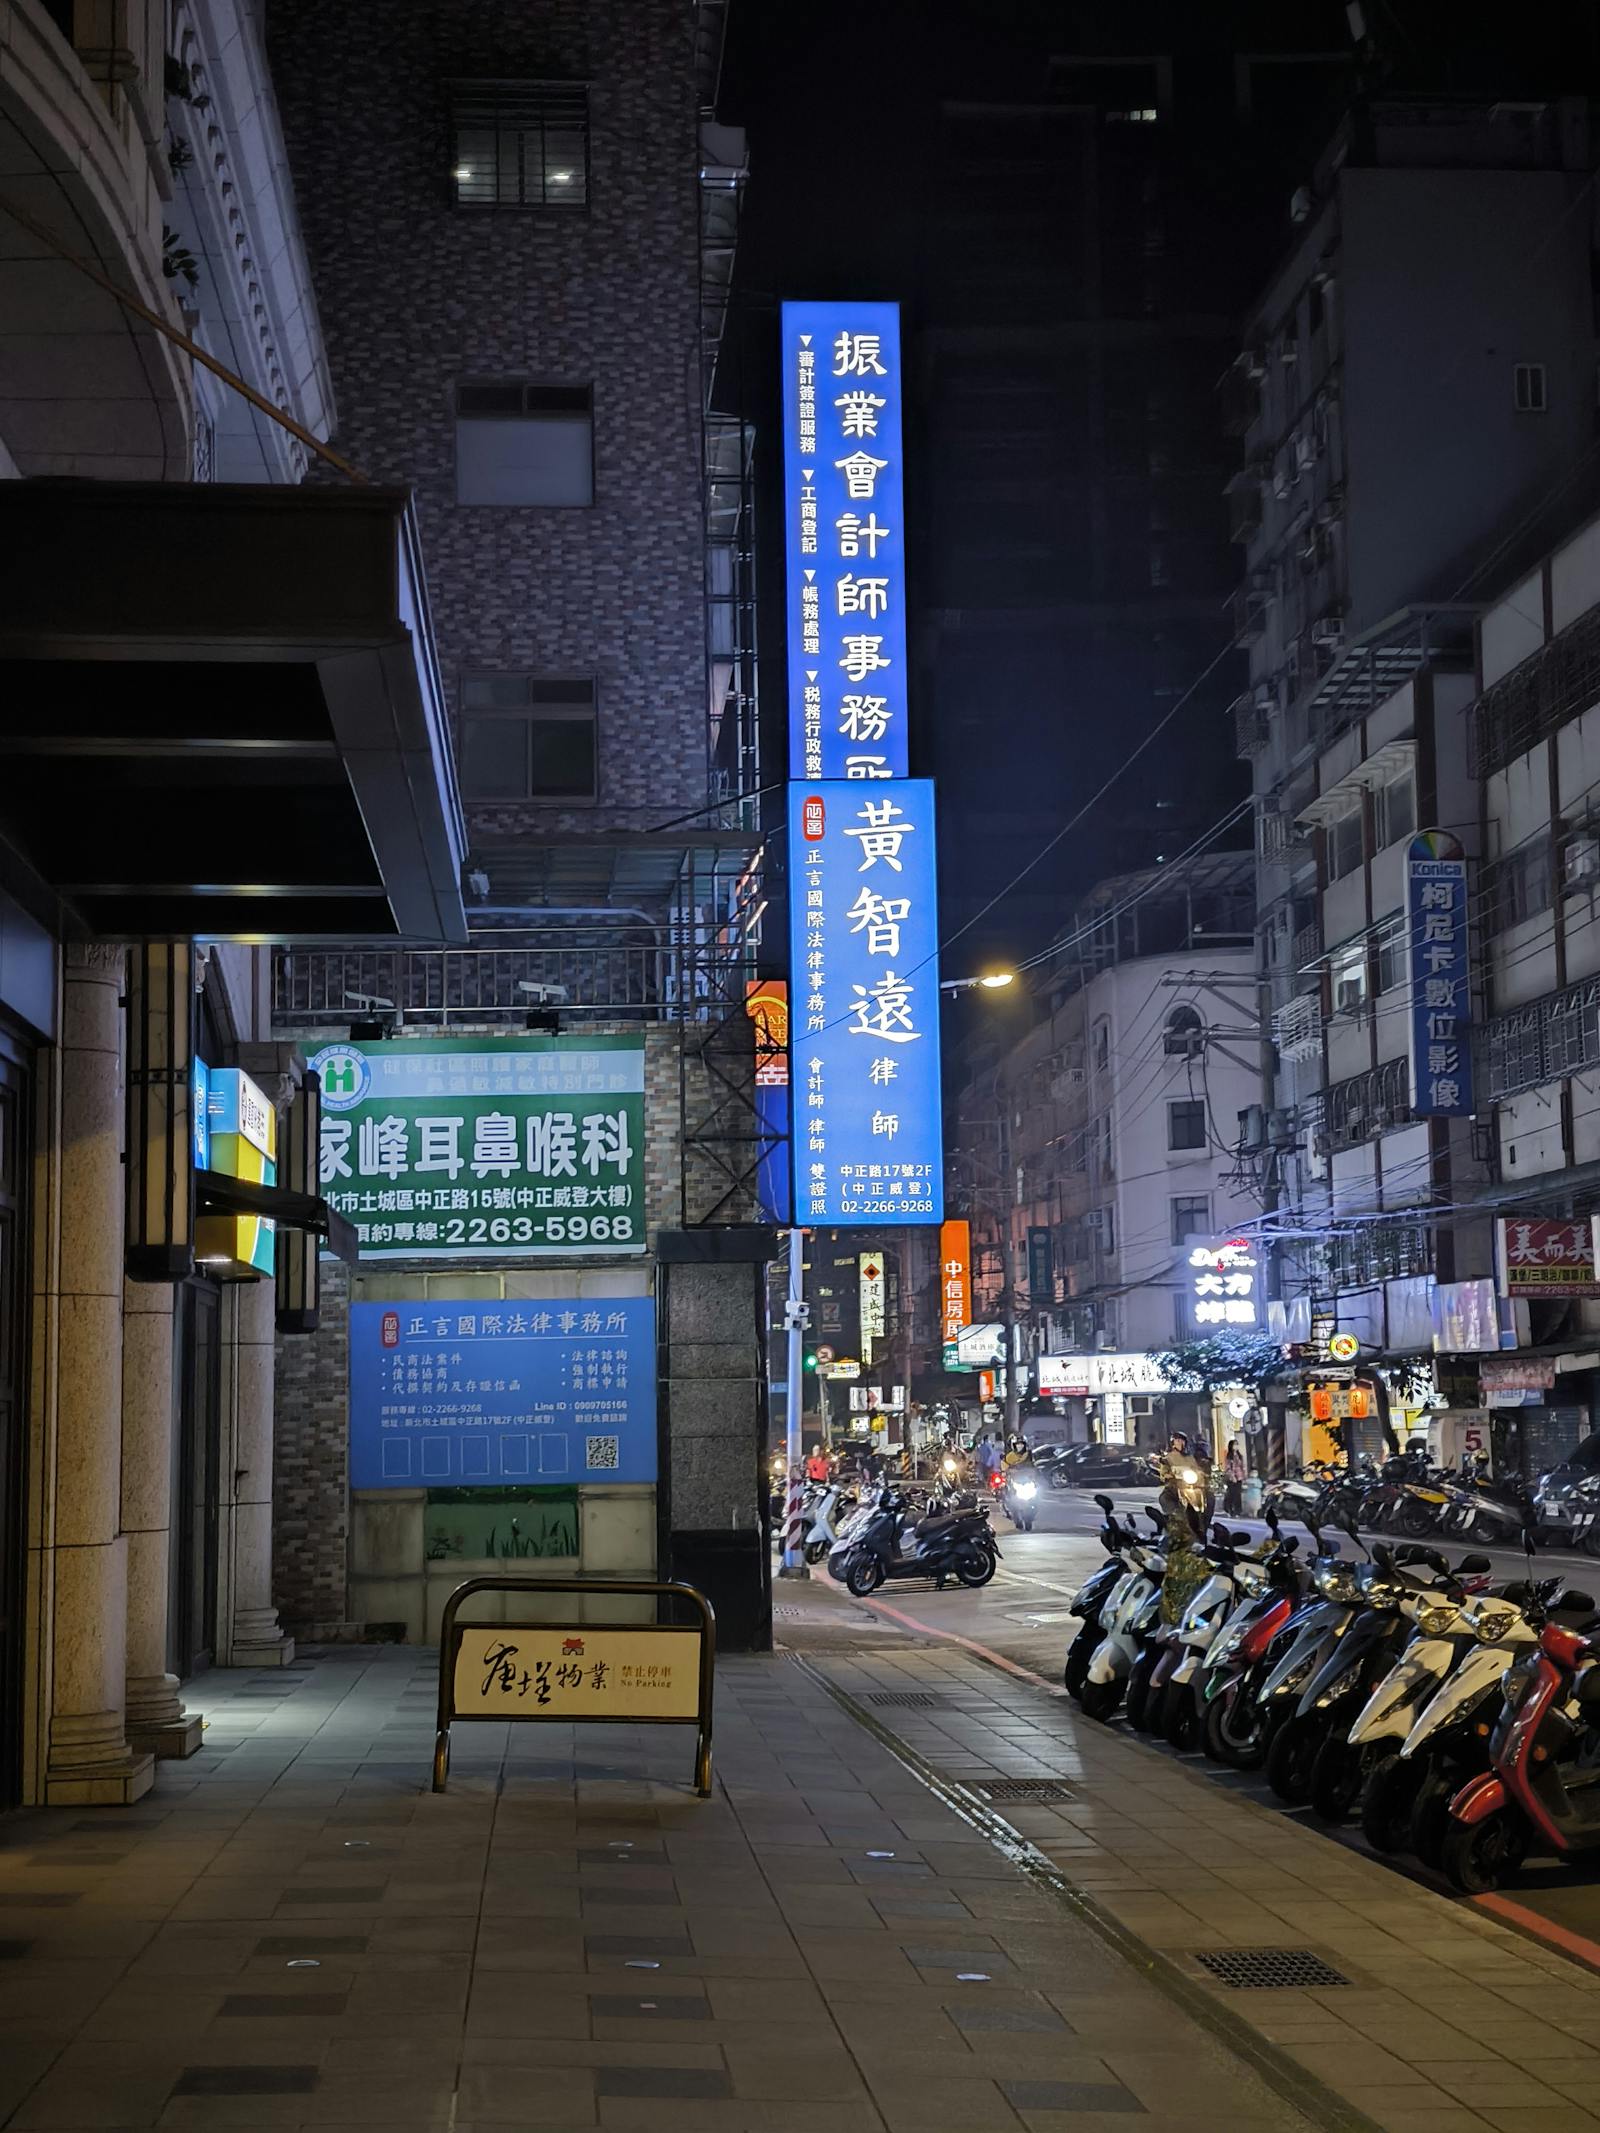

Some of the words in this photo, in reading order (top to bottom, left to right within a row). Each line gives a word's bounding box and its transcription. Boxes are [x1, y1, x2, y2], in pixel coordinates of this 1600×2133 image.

[798, 351, 817, 454] 審計簽證服務
[801, 486, 818, 555] 工商登記
[802, 586, 820, 654] 帳務處理
[1411, 862, 1463, 877] Konica
[805, 850, 826, 1032] 正言國際法律事務所
[1420, 882, 1460, 1108] 柯尼卡數位影像
[808, 1057, 825, 1109] 會計師
[868, 1056, 899, 1140] 律師
[320, 1110, 633, 1183] 家峰耳鼻喉科
[808, 1118, 825, 1153] 律師
[840, 1164, 932, 1178] 中正路17號2F
[841, 1200, 933, 1213] 02-2266-9268
[1510, 1225, 1594, 1265] 美而美
[405, 1311, 628, 1337] 正言國際法律事務所
[1465, 1430, 1482, 1451] 5
[620, 1679, 632, 1688] No
[636, 1679, 672, 1689] Parking
[621, 1665, 672, 1678] 禁止停車
